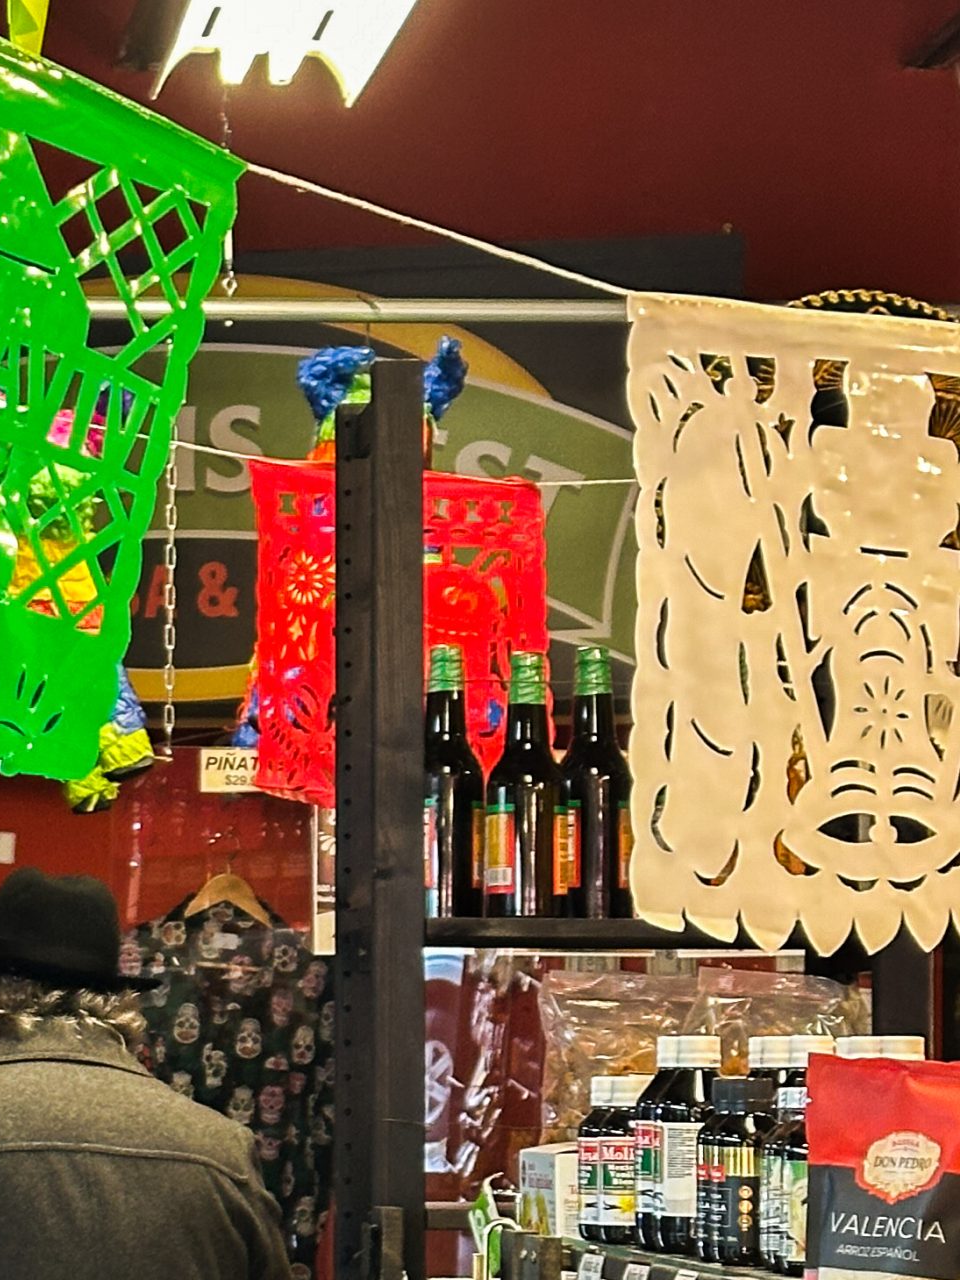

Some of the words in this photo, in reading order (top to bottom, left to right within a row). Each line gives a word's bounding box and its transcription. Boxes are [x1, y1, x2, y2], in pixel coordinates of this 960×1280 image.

[197, 561, 238, 618] &
[205, 752, 259, 771] PIÑAT
[601, 1145, 634, 1161] Moli
[874, 1156, 897, 1169] DON
[899, 1156, 933, 1171] PEDRO
[831, 1211, 946, 1244] VALENCIA
[870, 1244, 921, 1262] ESPAÑOL
